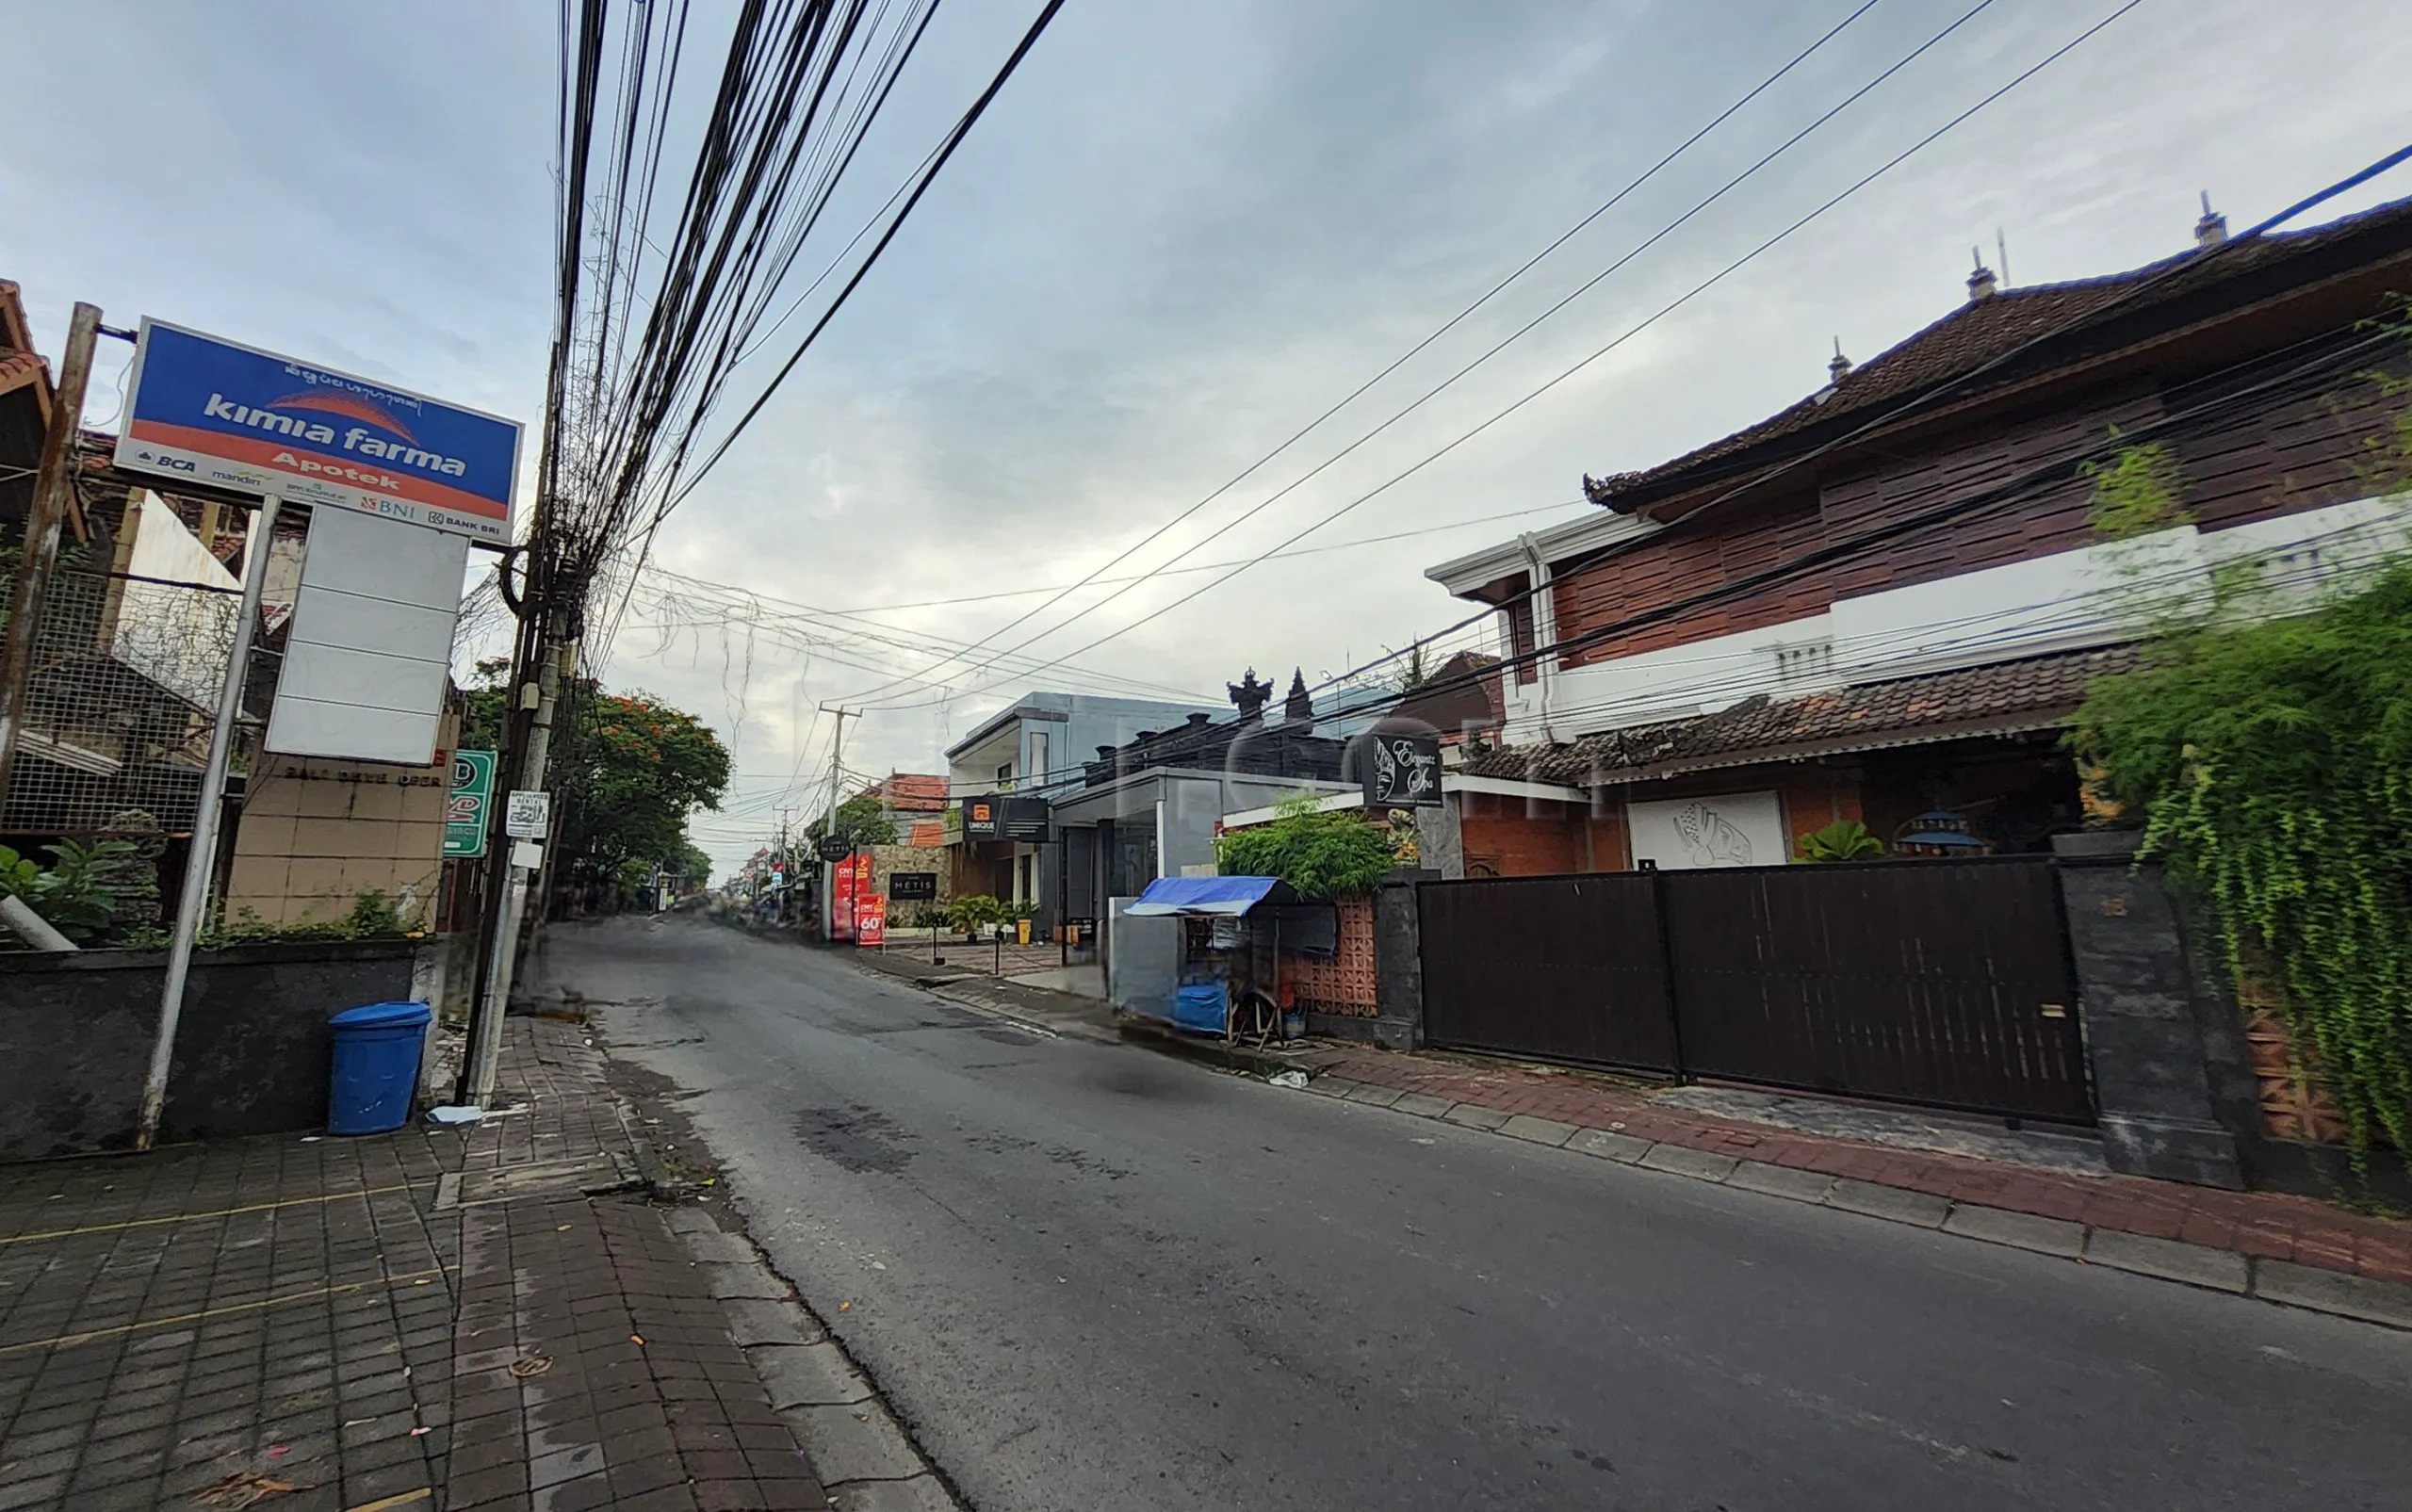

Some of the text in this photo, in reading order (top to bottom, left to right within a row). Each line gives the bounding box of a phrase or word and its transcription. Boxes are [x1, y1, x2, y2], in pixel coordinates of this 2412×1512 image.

[204, 393, 466, 478] kimia farma
[156, 456, 196, 473] BCA
[271, 452, 399, 491] Apotek
[212, 471, 261, 486] mandiri
[380, 500, 415, 518] BNI
[446, 517, 500, 535] BANK BRI
